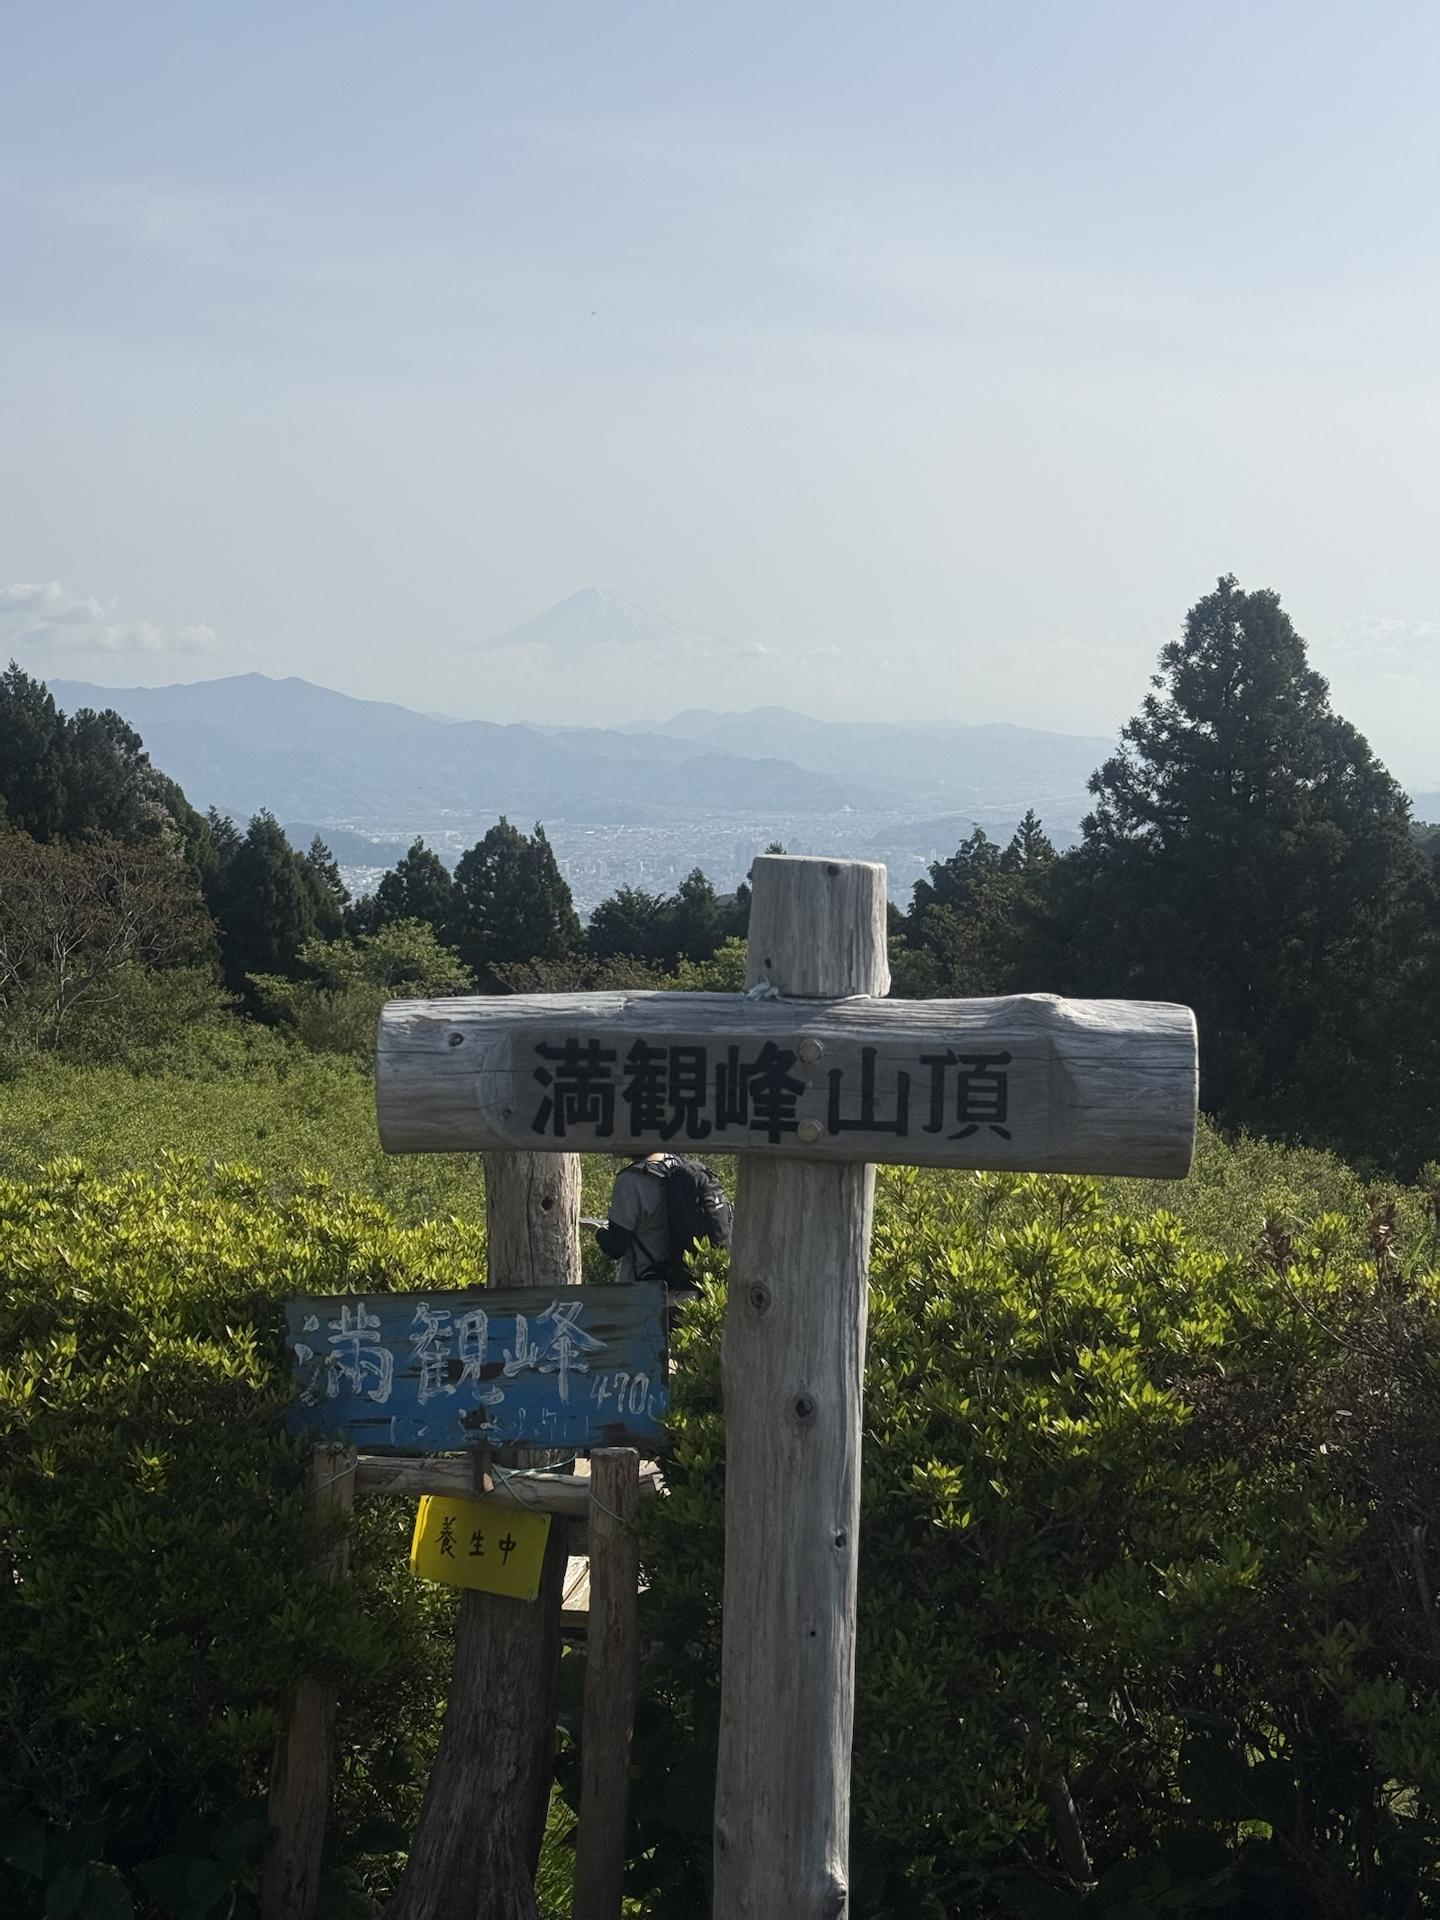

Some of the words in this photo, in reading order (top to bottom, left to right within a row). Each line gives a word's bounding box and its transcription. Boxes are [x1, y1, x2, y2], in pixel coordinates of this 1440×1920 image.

[531, 1038, 1013, 1144] 満観峰山頂
[294, 1300, 607, 1406] 満観峰
[435, 1516, 517, 1566] 養生中
